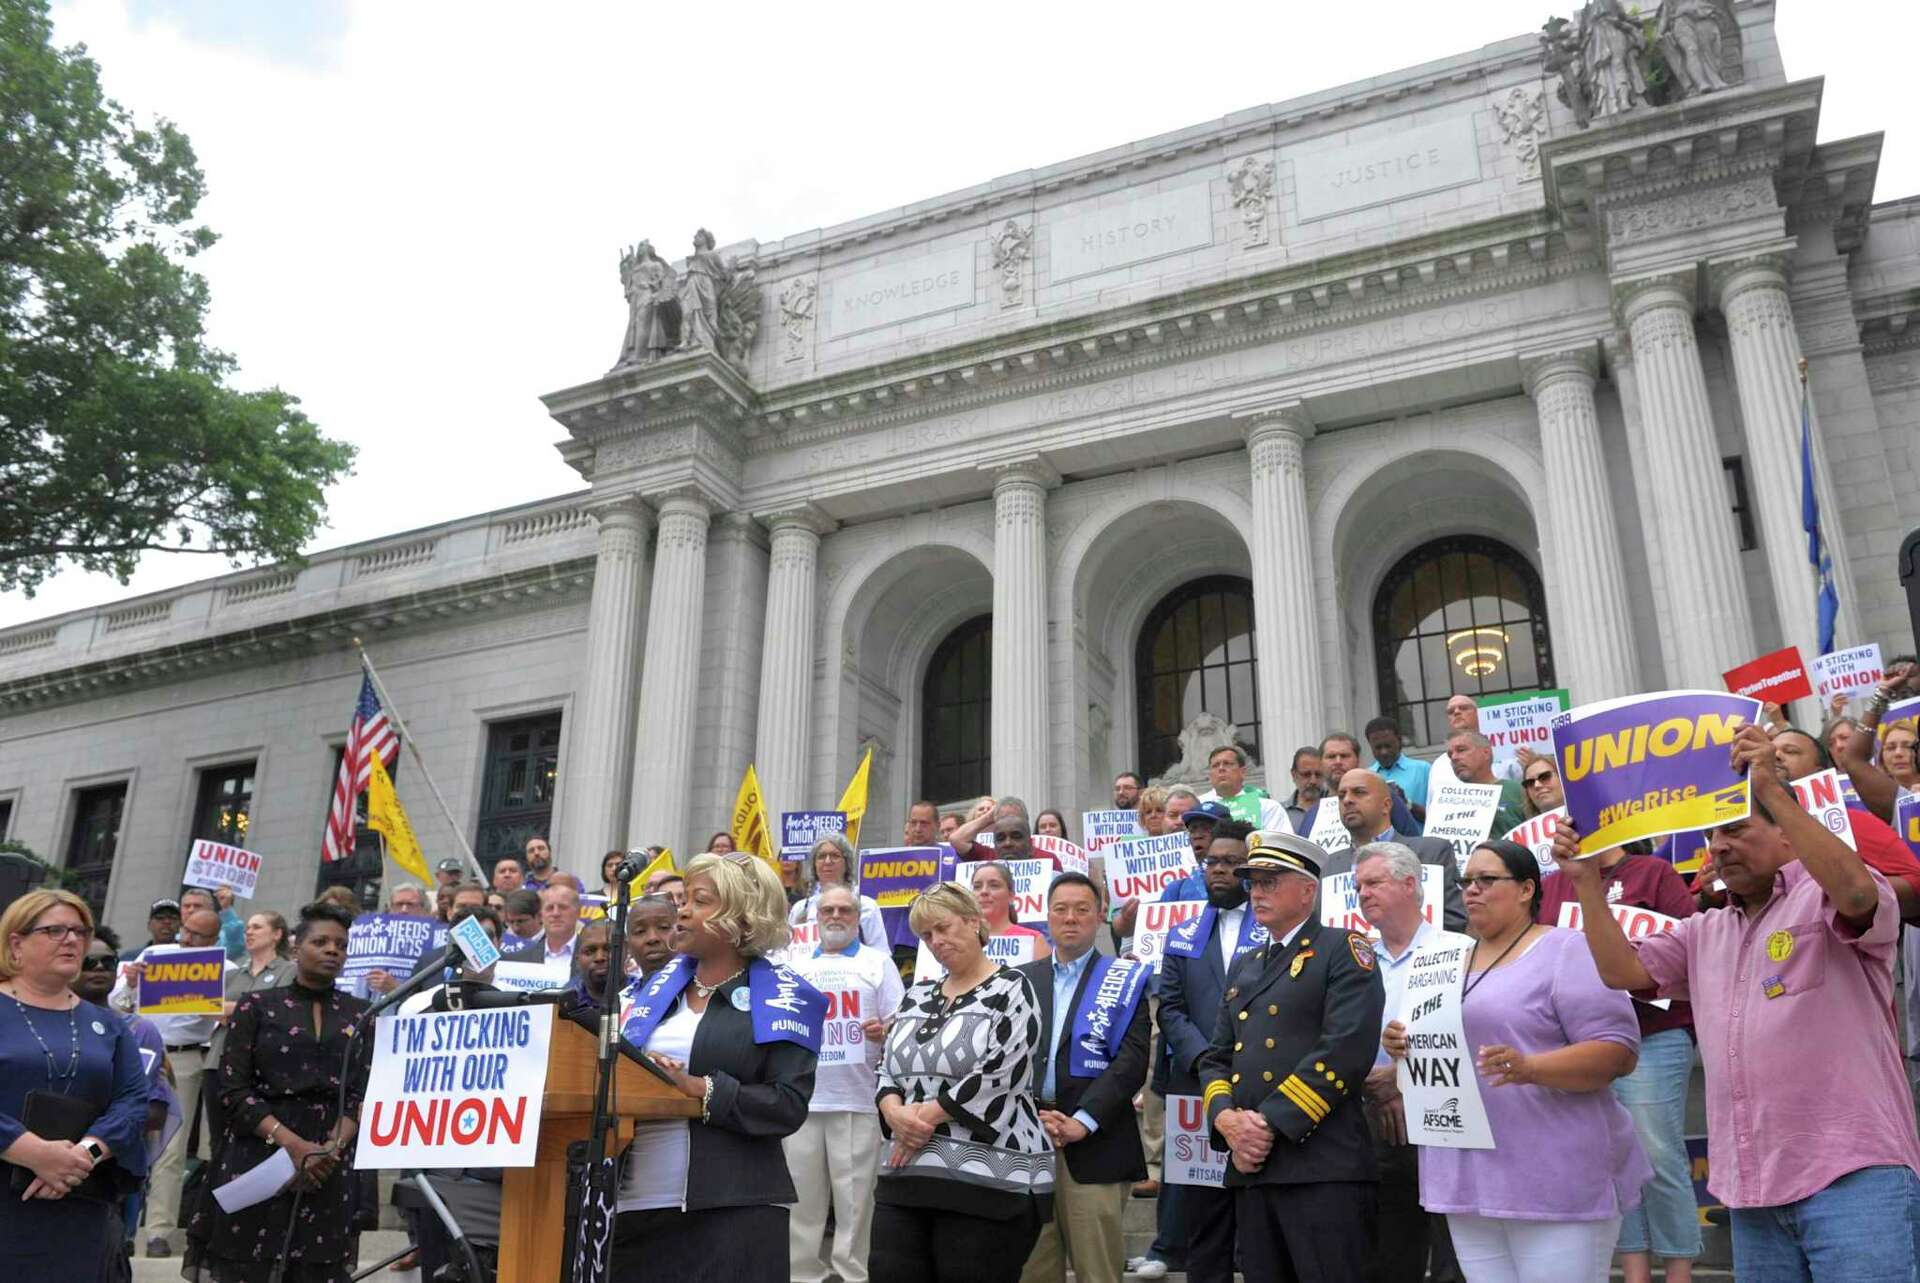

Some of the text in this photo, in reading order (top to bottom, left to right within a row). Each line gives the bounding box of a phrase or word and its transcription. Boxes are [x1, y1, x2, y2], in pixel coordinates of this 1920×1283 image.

[1329, 147, 1441, 188] JUSTICE
[1080, 215, 1176, 254] HISTORY
[843, 269, 961, 313] KNOWLEDGE
[808, 299, 1515, 472] STATE LIBRARY MEMORIAL HALL SUPREME COURT
[1825, 648, 1873, 667] STICKING
[1829, 663, 1855, 676] WITH
[1831, 669, 1881, 691] UNION
[1504, 701, 1553, 718] STICKING
[1506, 717, 1533, 728] WITH
[1509, 726, 1549, 745] UNIO
[1563, 713, 1746, 782] UNION
[1438, 796, 1492, 808] BARGAINING
[1441, 786, 1495, 798] COLLECTIVE
[1444, 809, 1478, 822] IS THE
[1599, 784, 1698, 828] #WeRise
[813, 815, 844, 830] NEEDS
[1088, 812, 1101, 824] I'M
[788, 829, 814, 844] UNION
[1094, 823, 1134, 836] WITH OUR
[1430, 826, 1482, 838] AMERICAN
[198, 842, 261, 870] UNION
[1114, 840, 1134, 859] I'M
[1137, 832, 1191, 856] STICKING
[1451, 839, 1477, 856] AY
[863, 860, 938, 879] UNION
[1125, 851, 1183, 875] WITH OUR
[191, 860, 256, 888] STRONG
[388, 919, 431, 941] NEEDS
[346, 936, 388, 956] UNION
[1413, 948, 1461, 969] COLLECTIVE
[143, 962, 221, 983] UNION
[1407, 968, 1458, 989] BARGAINING
[1411, 993, 1444, 1023] IS THE
[391, 1010, 530, 1054] I'M STICKING
[771, 1019, 810, 1038] #UNION
[402, 1053, 508, 1093] WITH OUR
[1406, 1057, 1461, 1088] WAY
[369, 1096, 528, 1147] UNION
[1423, 1113, 1463, 1128] AFSCME
